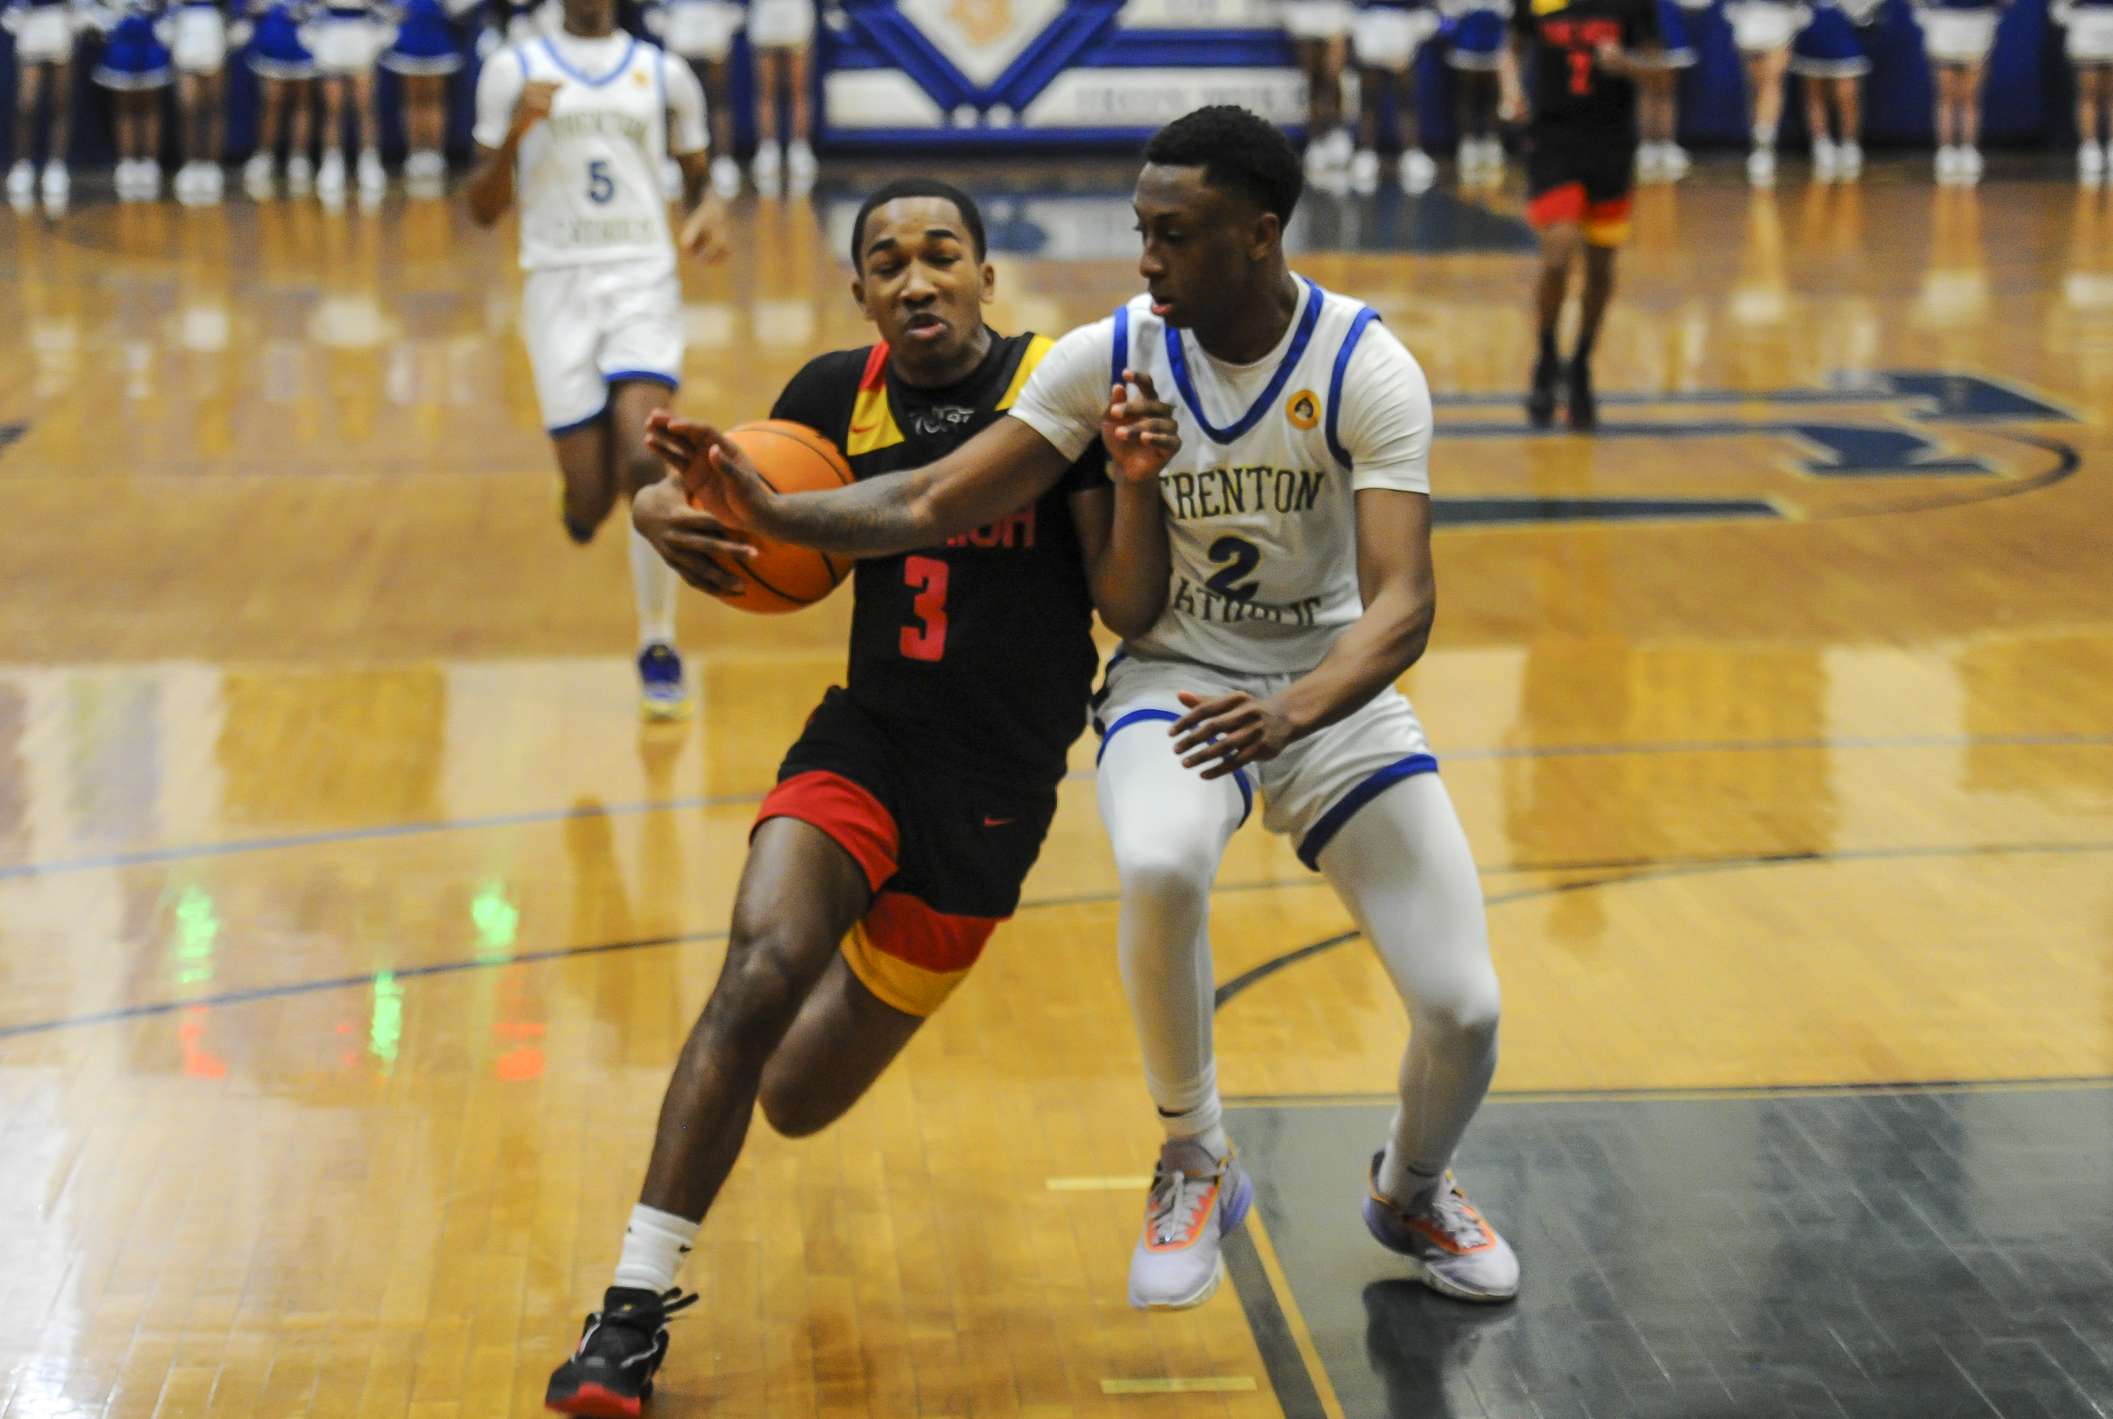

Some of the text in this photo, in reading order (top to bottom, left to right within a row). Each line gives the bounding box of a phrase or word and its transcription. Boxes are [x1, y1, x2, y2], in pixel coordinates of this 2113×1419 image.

[587, 159, 615, 205] 5
[1206, 535, 1262, 600] 2
[899, 554, 949, 662] 3
